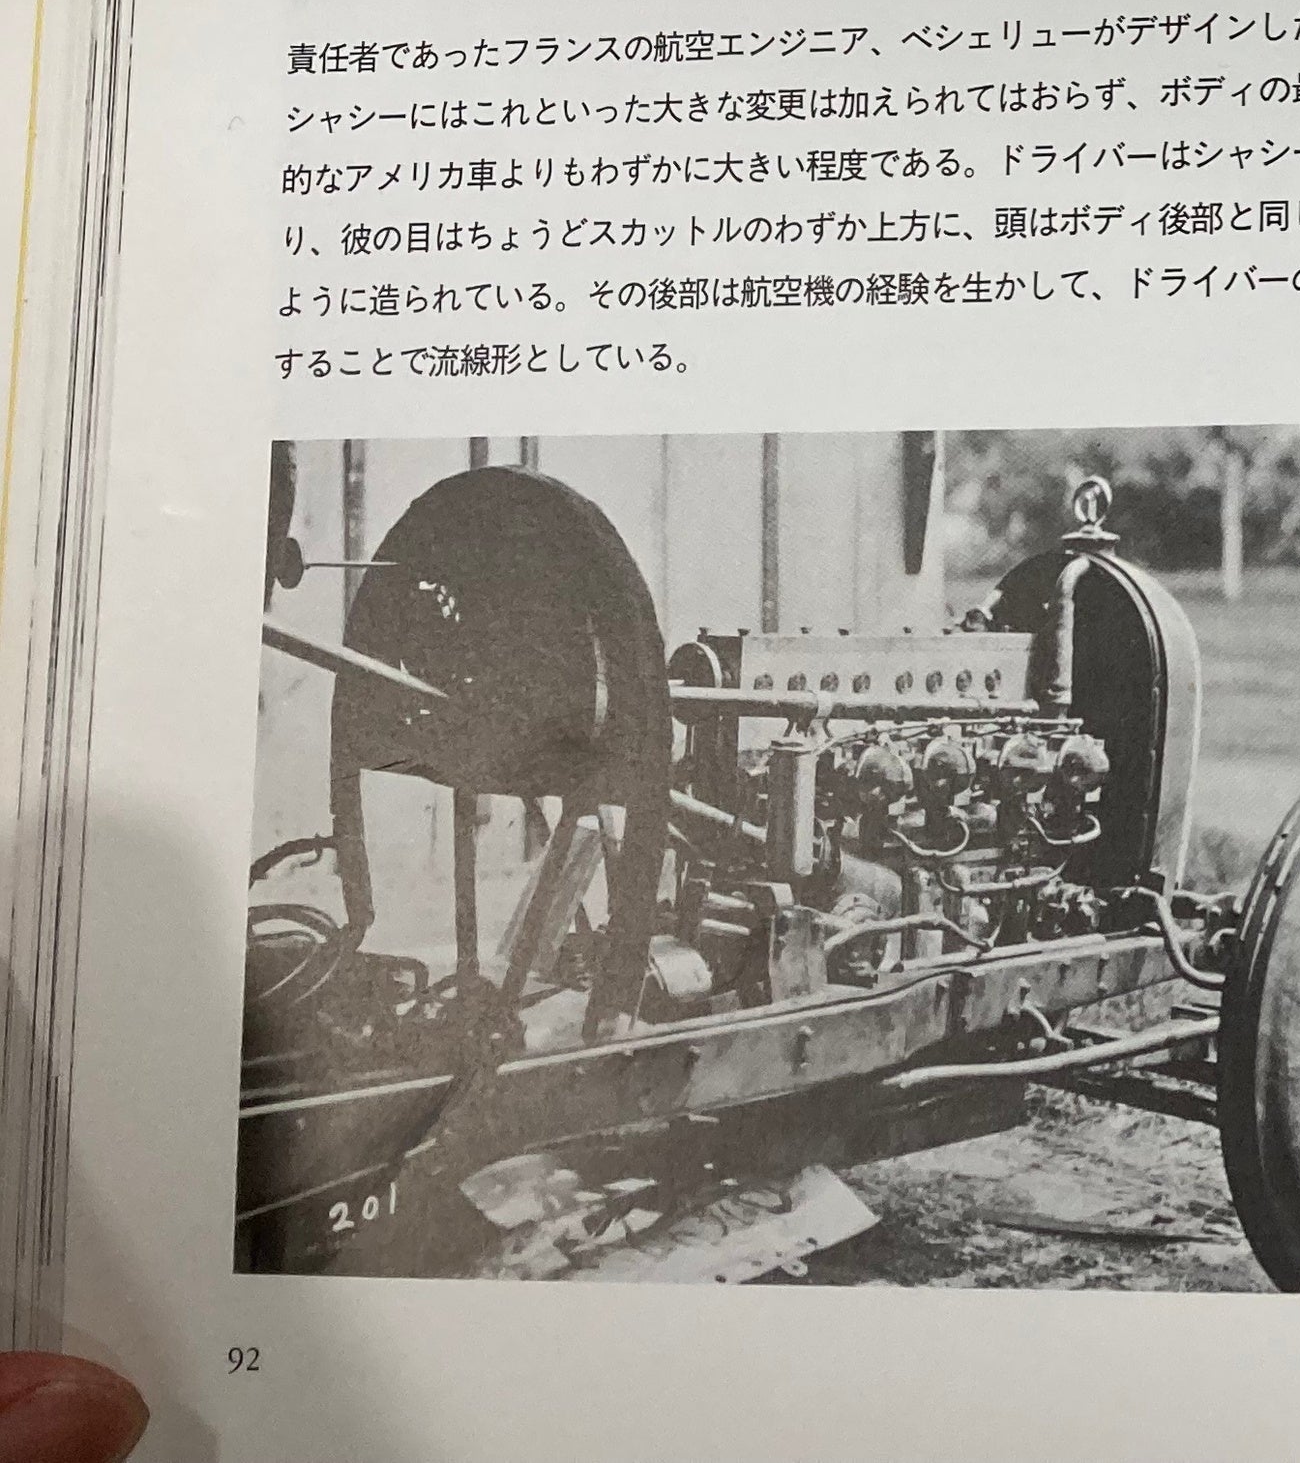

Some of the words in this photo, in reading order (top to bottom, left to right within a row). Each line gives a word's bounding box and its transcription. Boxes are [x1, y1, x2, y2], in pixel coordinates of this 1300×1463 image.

[275, 343, 690, 379] することで流線形としている。
[328, 1181, 397, 1232] 201
[228, 1347, 259, 1374] 92
